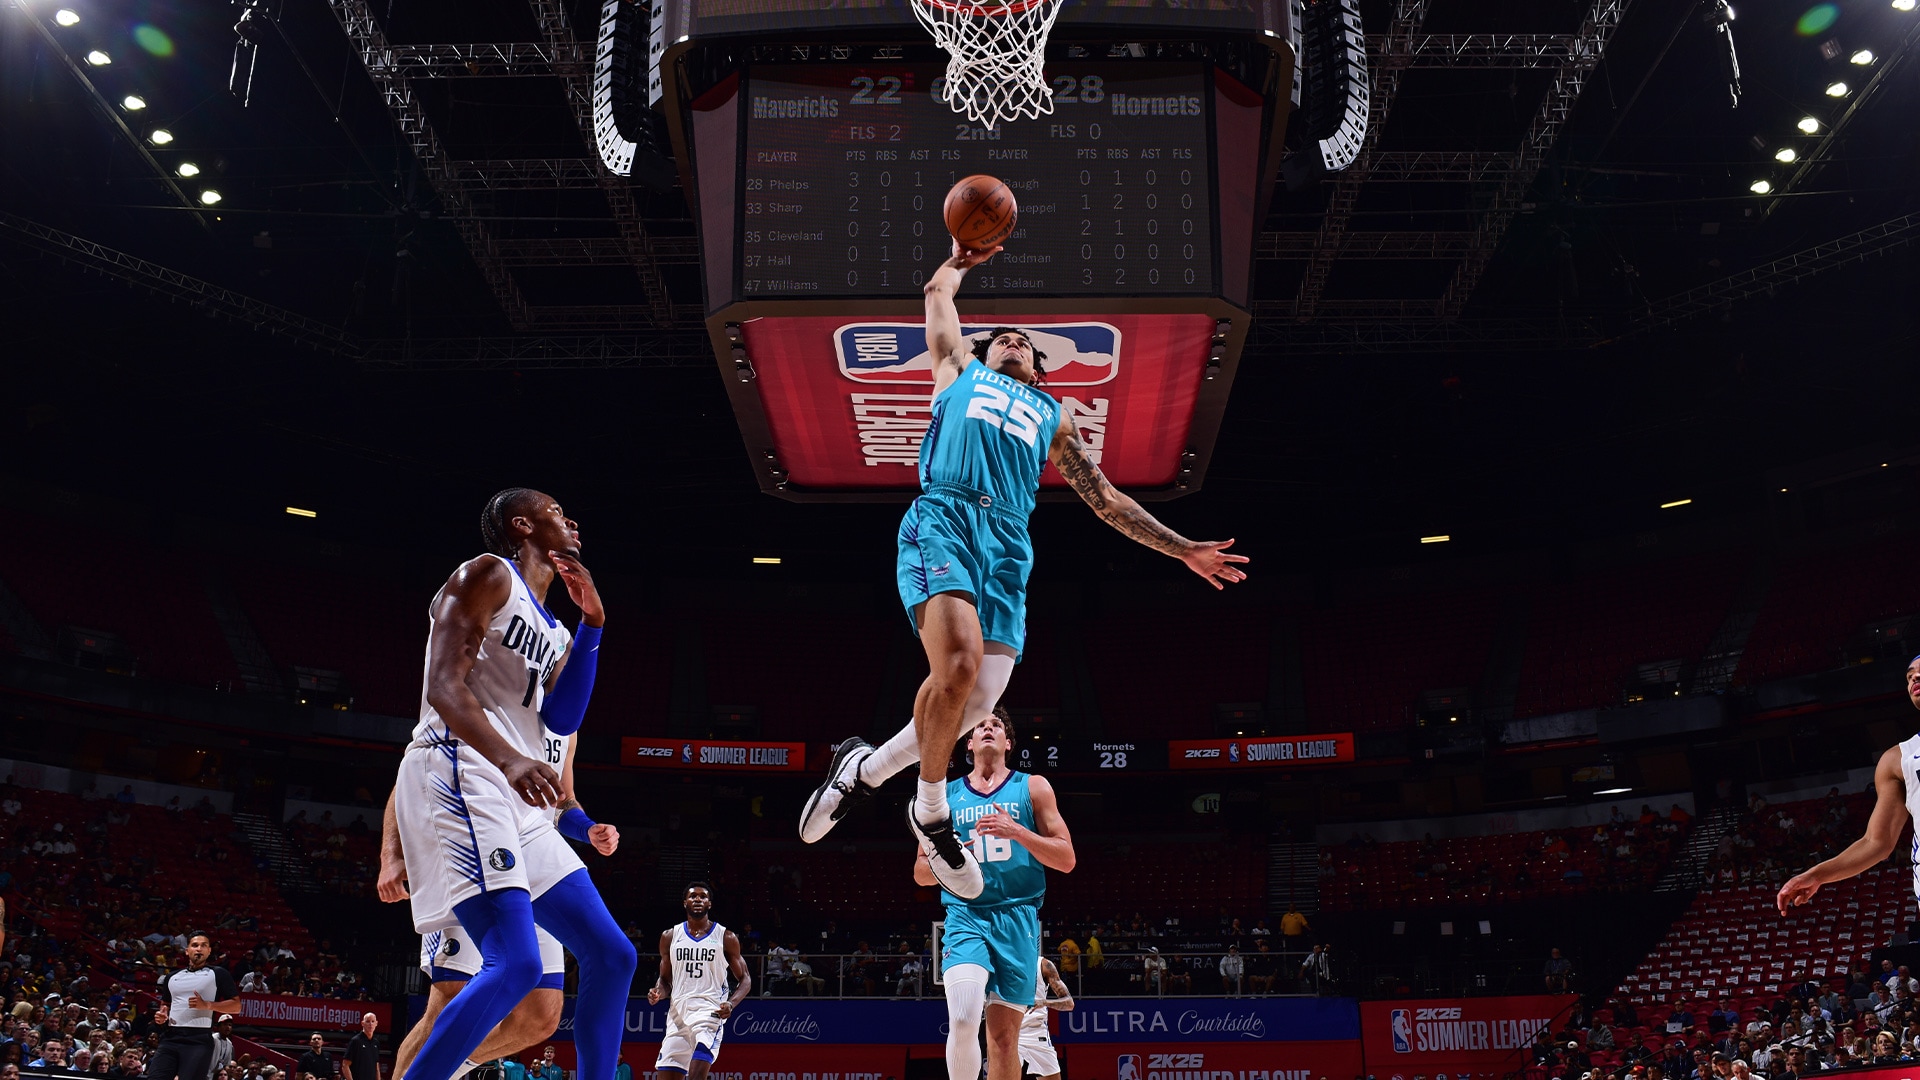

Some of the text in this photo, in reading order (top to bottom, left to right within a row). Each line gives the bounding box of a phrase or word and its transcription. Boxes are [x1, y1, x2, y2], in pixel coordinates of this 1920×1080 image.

[850, 76, 902, 104] 22
[1053, 75, 1105, 104] 28
[753, 96, 839, 118] Mavericks
[1112, 93, 1200, 116] Hornets
[851, 125, 901, 141] FLS 2
[956, 124, 1000, 140] 2nd
[1050, 123, 1101, 140] FLS 0
[757, 150, 961, 163] PLAYER PTS RBS AST FLS
[988, 149, 1192, 160] PLAYER PTS RBS AST FLS
[747, 171, 955, 191] 28 Phelps 3 0 1 1
[1080, 170, 1090, 185] 0
[1114, 170, 1123, 185] 1
[1146, 170, 1156, 185] 0
[1181, 170, 1191, 185] 0
[746, 195, 923, 215] 33 Sharp 2 1 0
[1019, 194, 1192, 215] ueppel 1 2 0 0
[745, 221, 923, 243] 35 Cleveland 0 2 0
[1009, 219, 1193, 239] all 2 1 0 0
[745, 245, 923, 268] 37 Hall 0 1 0
[1004, 253, 1051, 263] Rodman
[1081, 244, 1091, 260] 0
[1114, 244, 1125, 260] 0
[1149, 244, 1158, 260] 0
[1184, 244, 1193, 260] 0
[744, 270, 923, 292] 47 Williams 0 1 0
[980, 268, 1194, 289] 31 Salaun 3 2 0 0
[854, 333, 899, 362] NBA
[966, 384, 1043, 448] 25
[850, 392, 933, 466] LEAGUE
[1063, 445, 1104, 511] WHY NOT ME?
[637, 746, 789, 765] 2K26 SUMMER LEAGUE
[1021, 749, 1030, 760] 0
[1047, 746, 1059, 760] 2
[1093, 742, 1135, 751] Hornets
[1185, 740, 1337, 762] 2K26 SUMMER LEAGUE
[1100, 752, 1127, 769] 28
[676, 948, 716, 962] DALLAS
[685, 962, 704, 979] 45
[239, 998, 360, 1028] #NBA2KSummerLeague
[1415, 1007, 1462, 1021] 2K26
[733, 1011, 820, 1041] Courtside
[1068, 1009, 1265, 1039] ULTRA Courtside
[1416, 1020, 1489, 1052] SUMMER
[1147, 1054, 1204, 1069] 2K26
